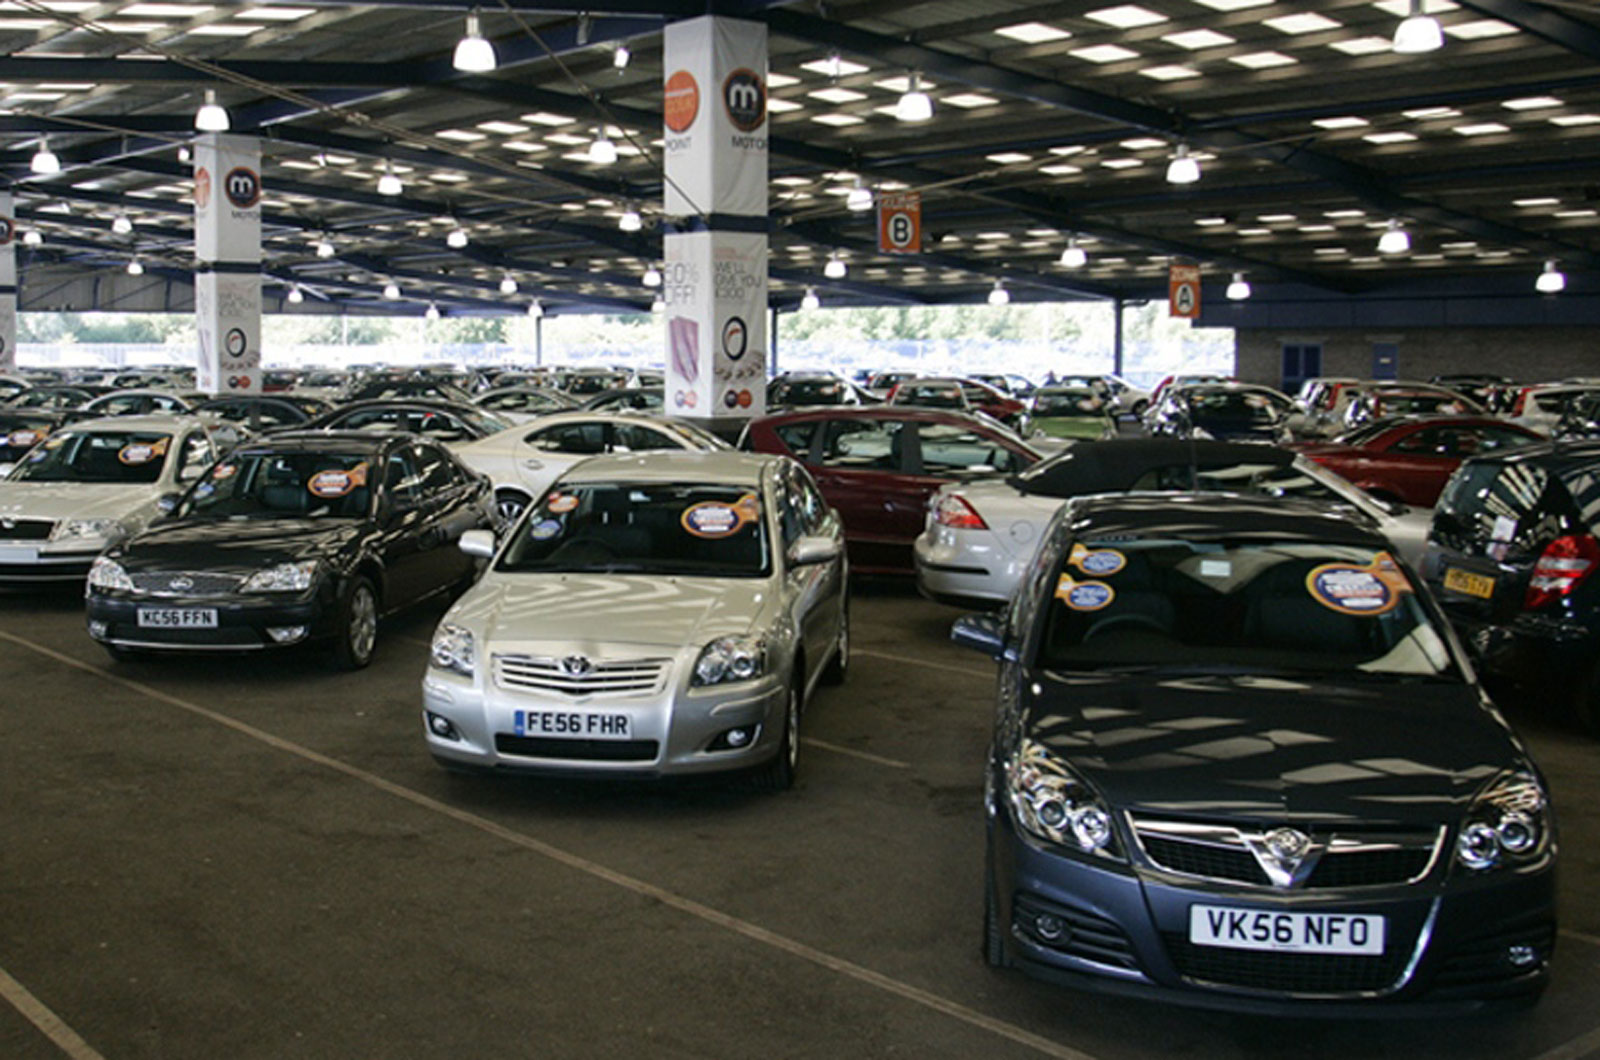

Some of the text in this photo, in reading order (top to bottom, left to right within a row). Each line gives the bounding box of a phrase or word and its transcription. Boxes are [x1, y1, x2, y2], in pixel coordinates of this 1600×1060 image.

[893, 217, 908, 243] B
[1178, 287, 1191, 306] A
[183, 611, 212, 625] FFN
[527, 712, 628, 735] FE56 FHR
[1207, 909, 1369, 946] VK56 NFO
